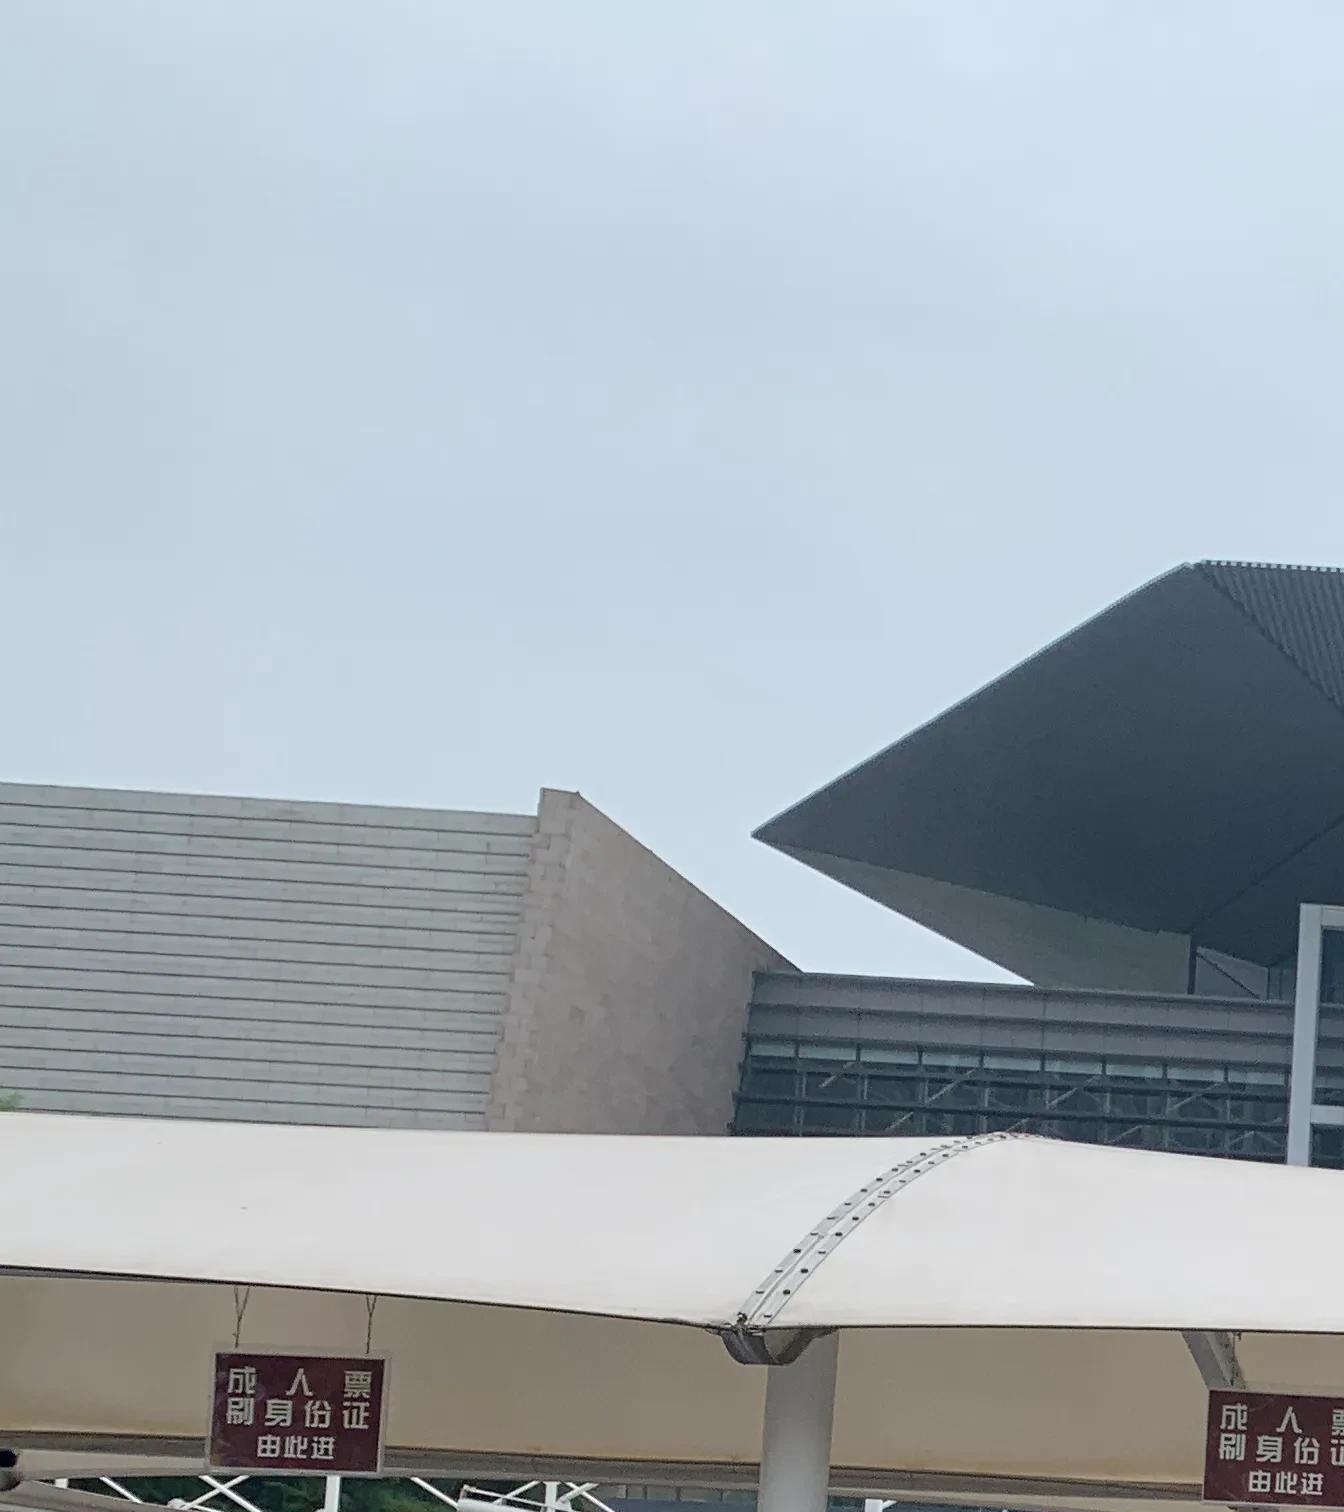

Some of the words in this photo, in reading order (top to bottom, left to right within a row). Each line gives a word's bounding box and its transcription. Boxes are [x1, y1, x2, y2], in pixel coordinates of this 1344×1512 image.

[227, 1366, 372, 1399] 成人票
[226, 1396, 370, 1430] 刷身份证
[256, 1434, 336, 1460] 由此进
[1248, 1469, 1324, 1496] 由此进
